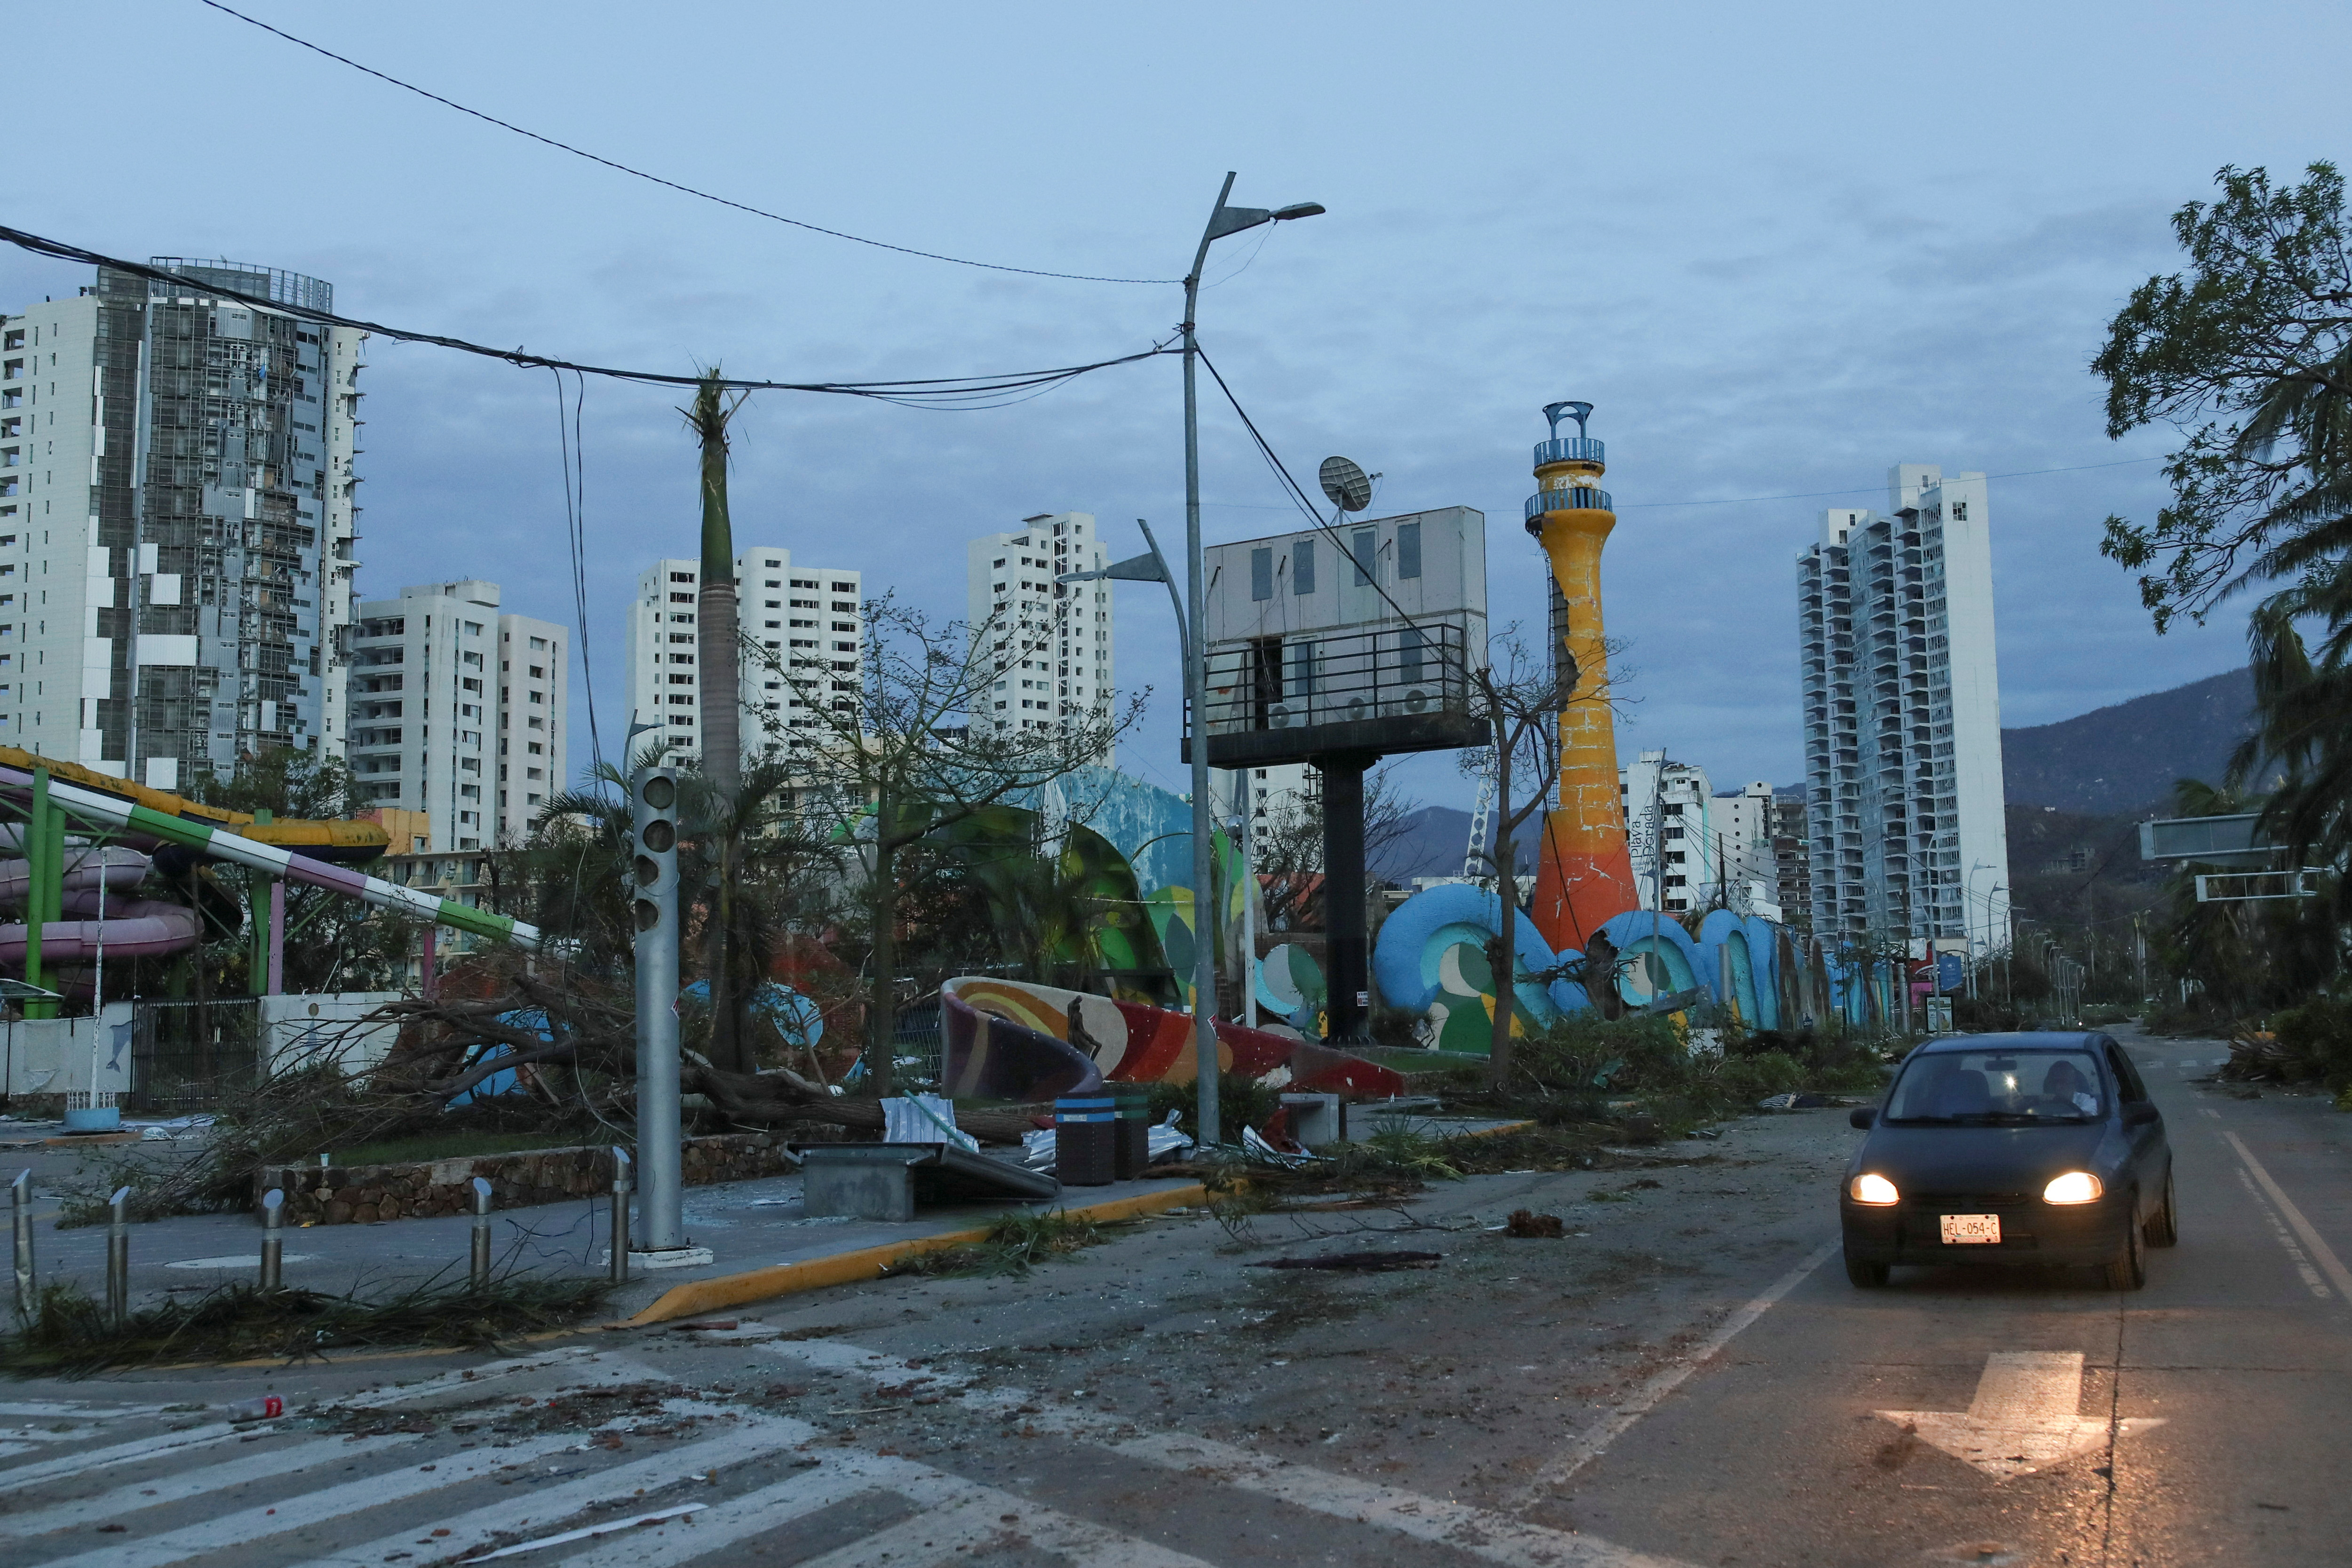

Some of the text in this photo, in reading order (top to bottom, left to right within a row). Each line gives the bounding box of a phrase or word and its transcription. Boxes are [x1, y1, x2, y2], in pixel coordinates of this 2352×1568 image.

[1631, 820, 1642, 858] Playa
[1640, 805, 1655, 857] Dorada
[1943, 1223, 1996, 1235] HEL-054-C
